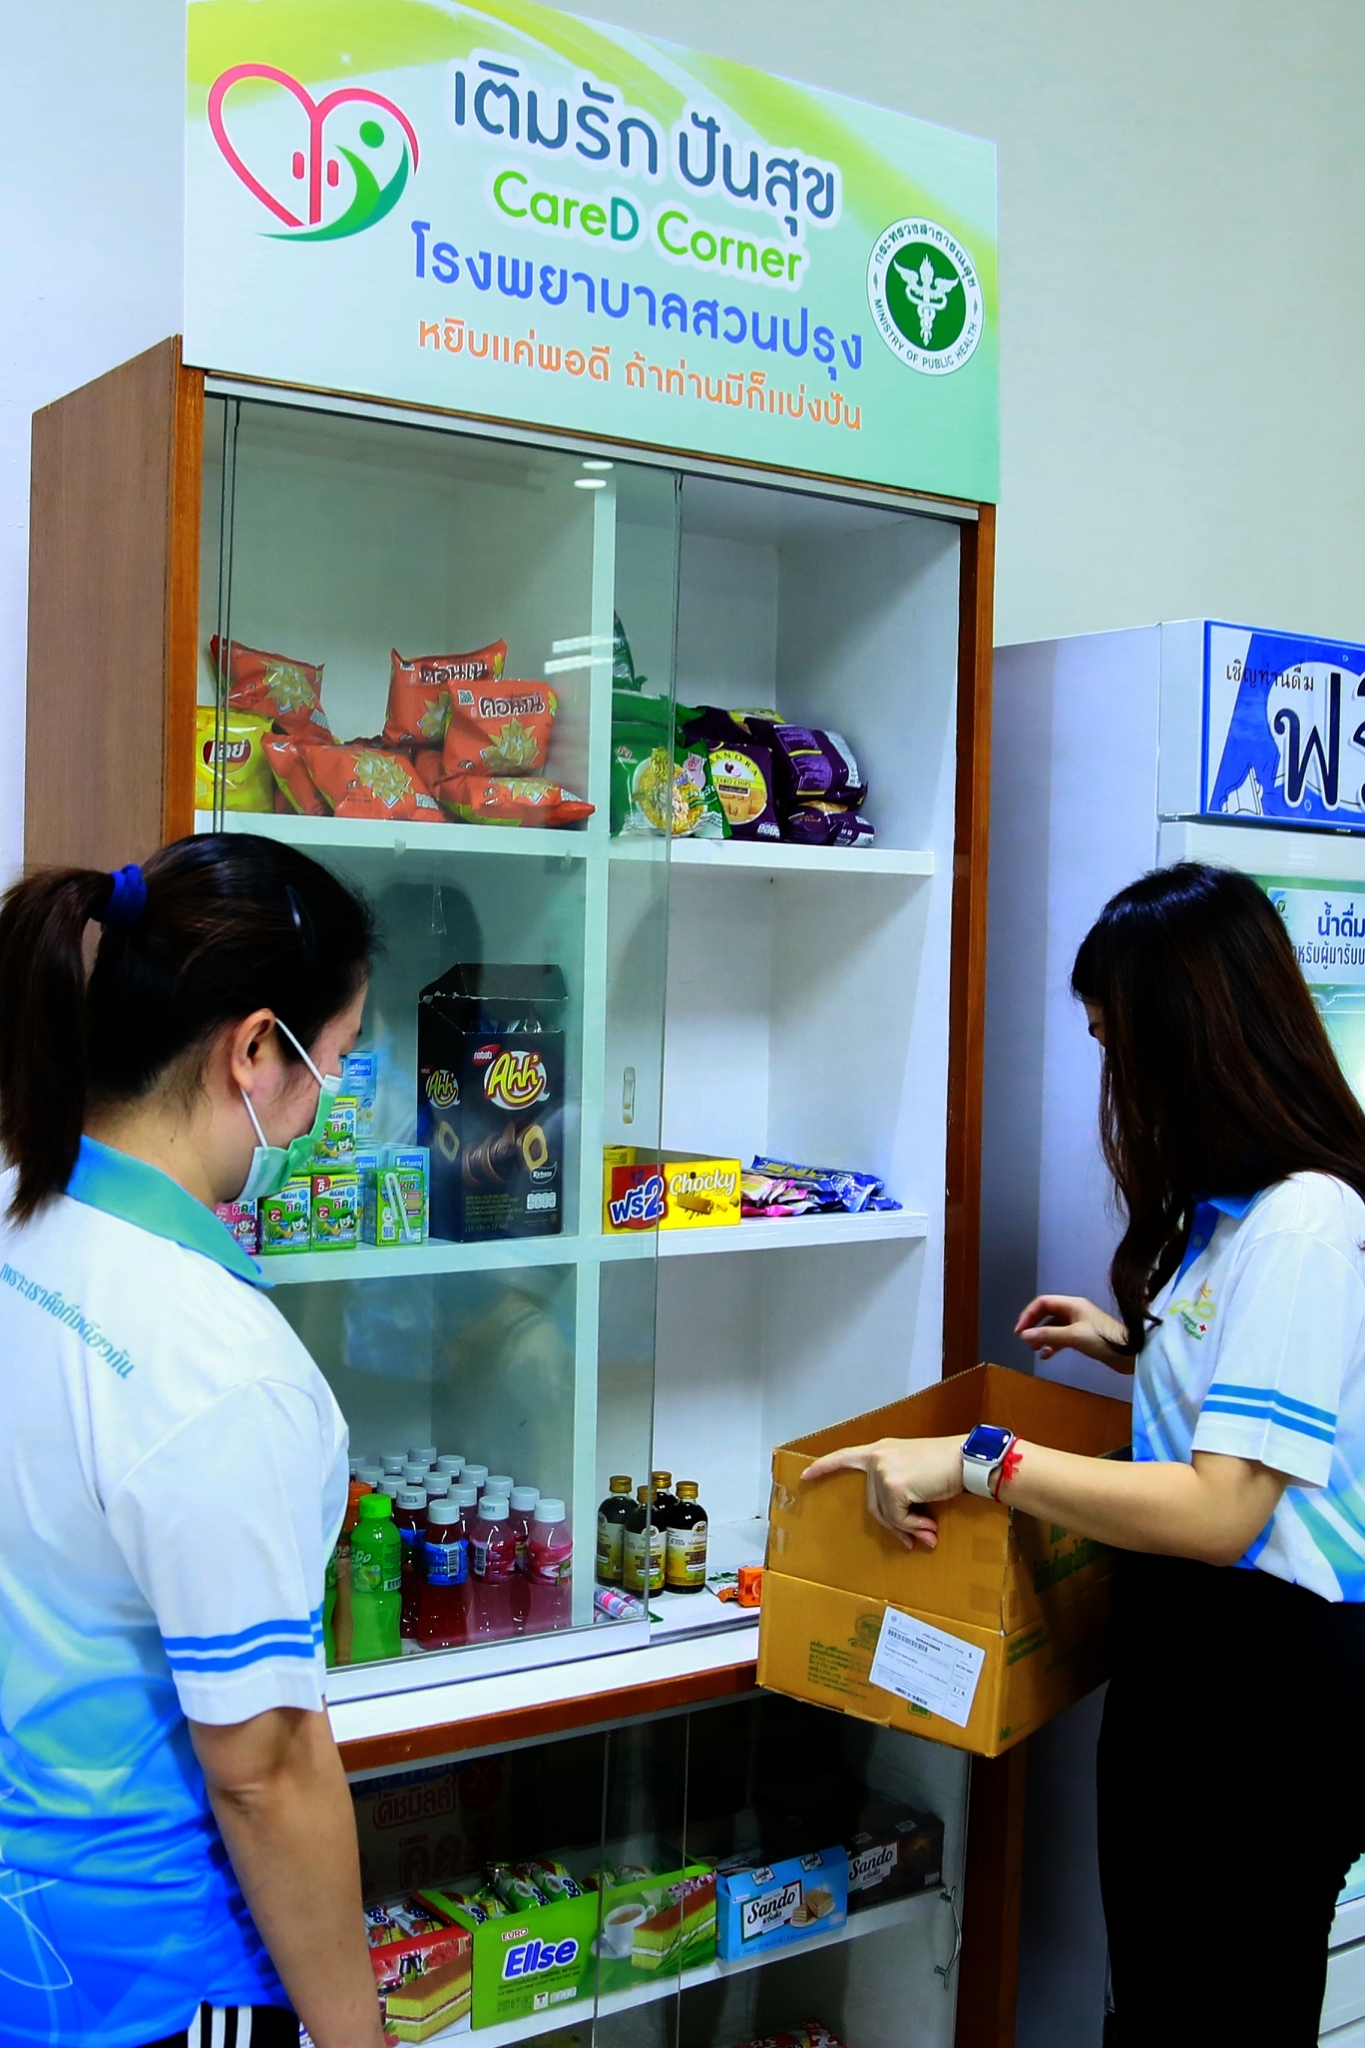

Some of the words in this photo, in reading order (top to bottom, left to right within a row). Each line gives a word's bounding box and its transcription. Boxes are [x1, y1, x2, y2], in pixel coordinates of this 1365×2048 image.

[454, 60, 658, 175] เติมรัก
[679, 112, 834, 237] ปันสุข
[493, 170, 640, 241] CareD
[657, 210, 803, 282] Corner
[410, 220, 863, 381] โรงพยาบาลสวนปรุง
[418, 318, 612, 382] หยิบแค่พอดี
[874, 299, 905, 351] MINISTRY
[907, 350, 919, 363] OF
[922, 355, 954, 370] PUBLIC
[955, 322, 978, 361] HEALTH
[669, 1168, 736, 1196] Chocky
[849, 1848, 893, 1880] Sando
[747, 1888, 796, 1925] Sando
[502, 1928, 529, 1941] EURO
[504, 1940, 577, 1978] Ellse
